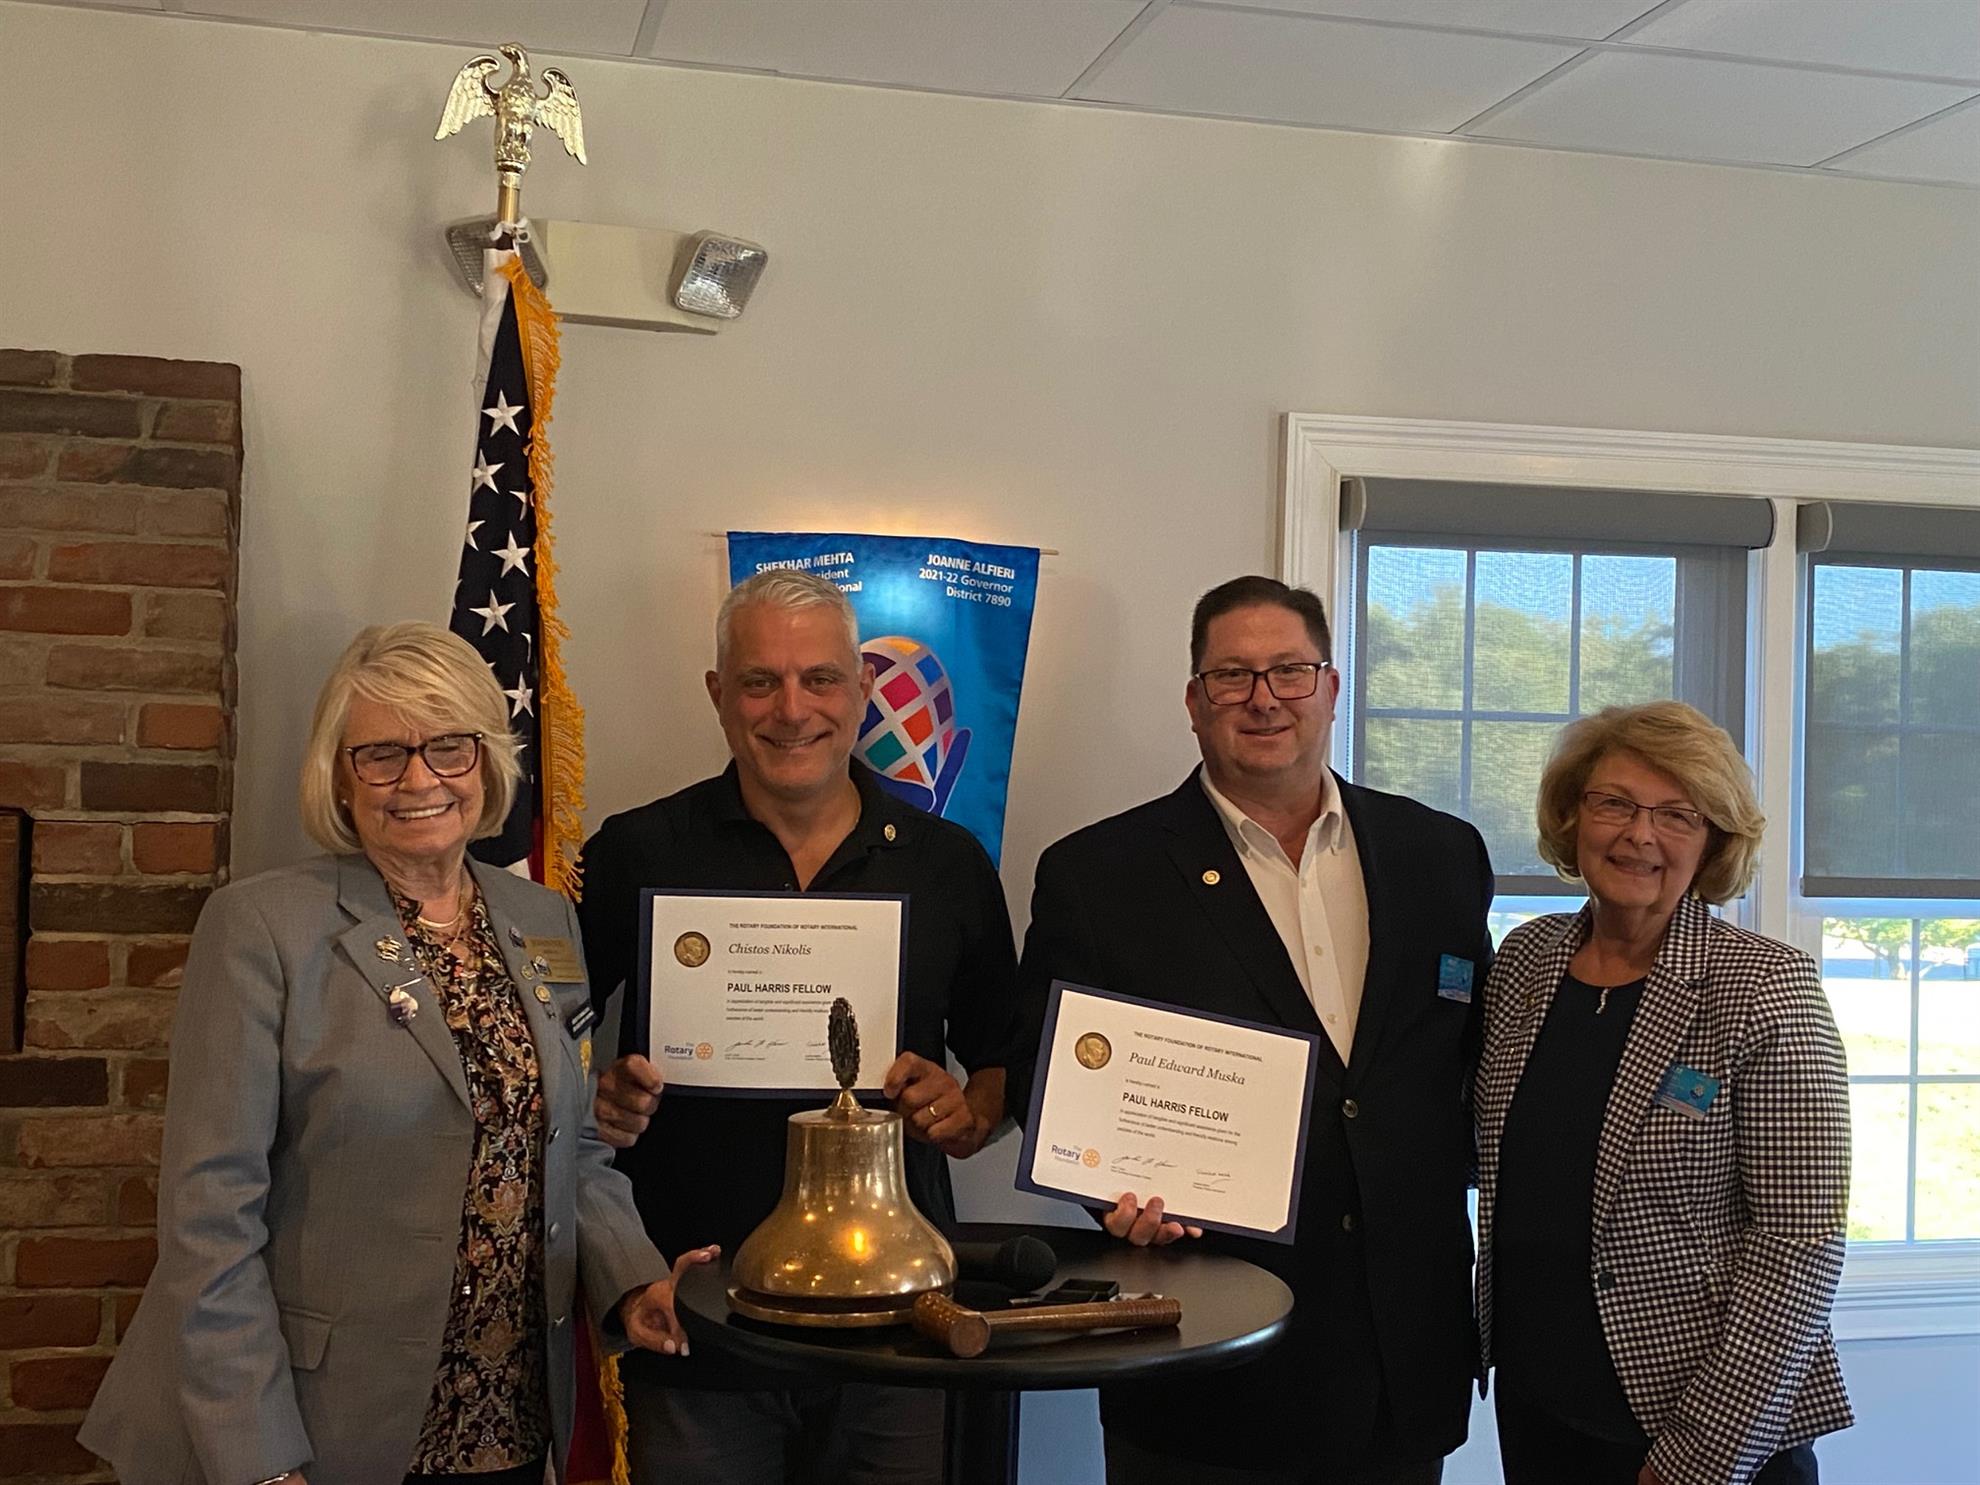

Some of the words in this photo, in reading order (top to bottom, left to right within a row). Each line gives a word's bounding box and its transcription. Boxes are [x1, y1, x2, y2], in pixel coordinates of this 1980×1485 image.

[756, 558, 811, 575] SHEKHAR
[813, 552, 855, 567] MEHTA
[927, 554, 972, 572] JOANNE
[972, 561, 1015, 580] ALFIERI
[919, 567, 958, 584] 2021-22
[961, 575, 1014, 593] Governor
[946, 586, 982, 602] District
[985, 593, 1012, 608] 7890
[728, 943, 770, 954] Chistos
[772, 944, 812, 955] Nikolis
[727, 983, 752, 992] PAUL
[755, 984, 790, 993] HARRIS
[792, 984, 832, 993] FELLOW
[664, 1045, 693, 1055] Rotary
[1143, 1033, 1163, 1041] ROTARY
[1164, 1037, 1196, 1048] FOUNDATION
[1224, 1050, 1263, 1062] INTERNATIONAL
[1129, 1052, 1156, 1067] Paul
[1157, 1058, 1206, 1077] Edward
[1206, 1067, 1245, 1085] Muska
[1122, 1092, 1148, 1106] PAUL
[1150, 1098, 1187, 1114] HARRIS
[1188, 1105, 1229, 1122] FELLOW
[1051, 1144, 1080, 1161] Rotary
